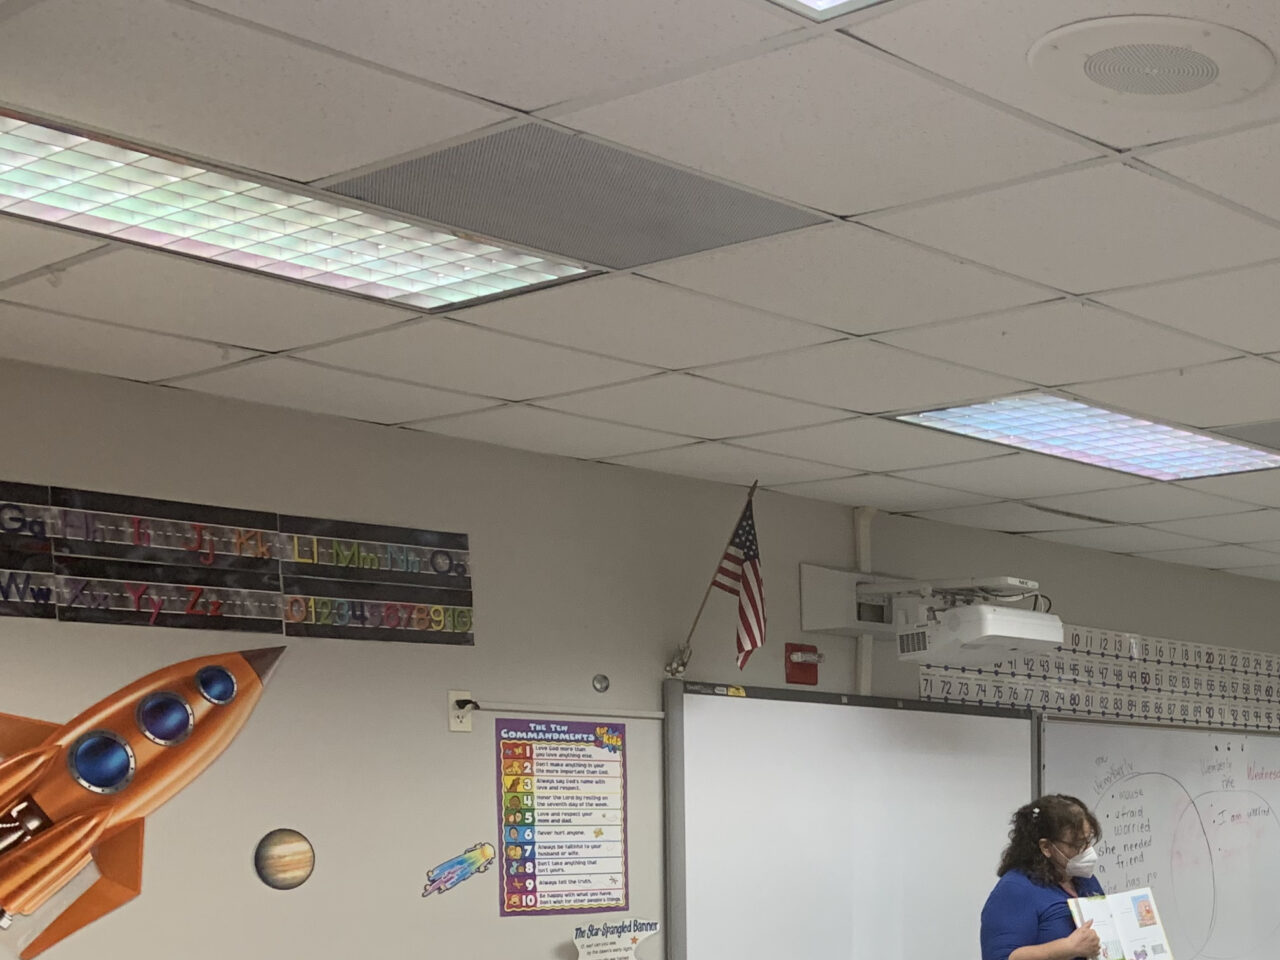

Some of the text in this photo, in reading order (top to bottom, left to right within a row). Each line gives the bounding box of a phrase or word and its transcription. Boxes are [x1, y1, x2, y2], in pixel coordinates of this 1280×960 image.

[183, 524, 215, 565] Jj
[234, 529, 270, 558] Kk
[332, 539, 380, 569] Mm
[387, 544, 420, 573] Nn
[430, 550, 467, 575] Oo
[125, 582, 164, 625] Yy
[185, 586, 223, 616] Zz
[1072, 633, 1080, 646] 10
[1085, 635, 1092, 648] 11
[1100, 638, 1108, 650] 12
[1114, 639, 1122, 652] 13
[1155, 645, 1163, 658] 16
[1170, 647, 1176, 658] 17
[1182, 648, 1188, 660] 18
[1206, 652, 1214, 664] 20
[1024, 657, 1034, 671] 42
[1040, 659, 1049, 673] 43
[1055, 661, 1064, 674] 44
[1070, 664, 1079, 676] 45
[1085, 665, 1094, 678] 46
[1099, 667, 1108, 679] 47
[1114, 668, 1122, 681] 48
[1128, 670, 1136, 682] 49
[1141, 672, 1150, 685] 50
[923, 679, 932, 692] 71
[940, 680, 951, 695] 72
[958, 682, 969, 696] 73
[976, 684, 986, 697] 74
[993, 685, 1003, 699] 75
[1008, 687, 1018, 700] 76
[1024, 688, 1034, 701] 77
[1040, 690, 1049, 703] 78
[1070, 693, 1080, 706] 80
[526, 746, 530, 757] 1
[524, 762, 532, 773] 2
[523, 779, 532, 790] 3
[523, 795, 532, 807] 4
[524, 812, 533, 823] 5
[524, 830, 532, 840] 6
[524, 846, 532, 856] 7
[525, 862, 534, 873] 8
[525, 880, 534, 890] 9
[522, 895, 535, 906] 10
[575, 927, 585, 939] The
[633, 920, 658, 932] Banner
